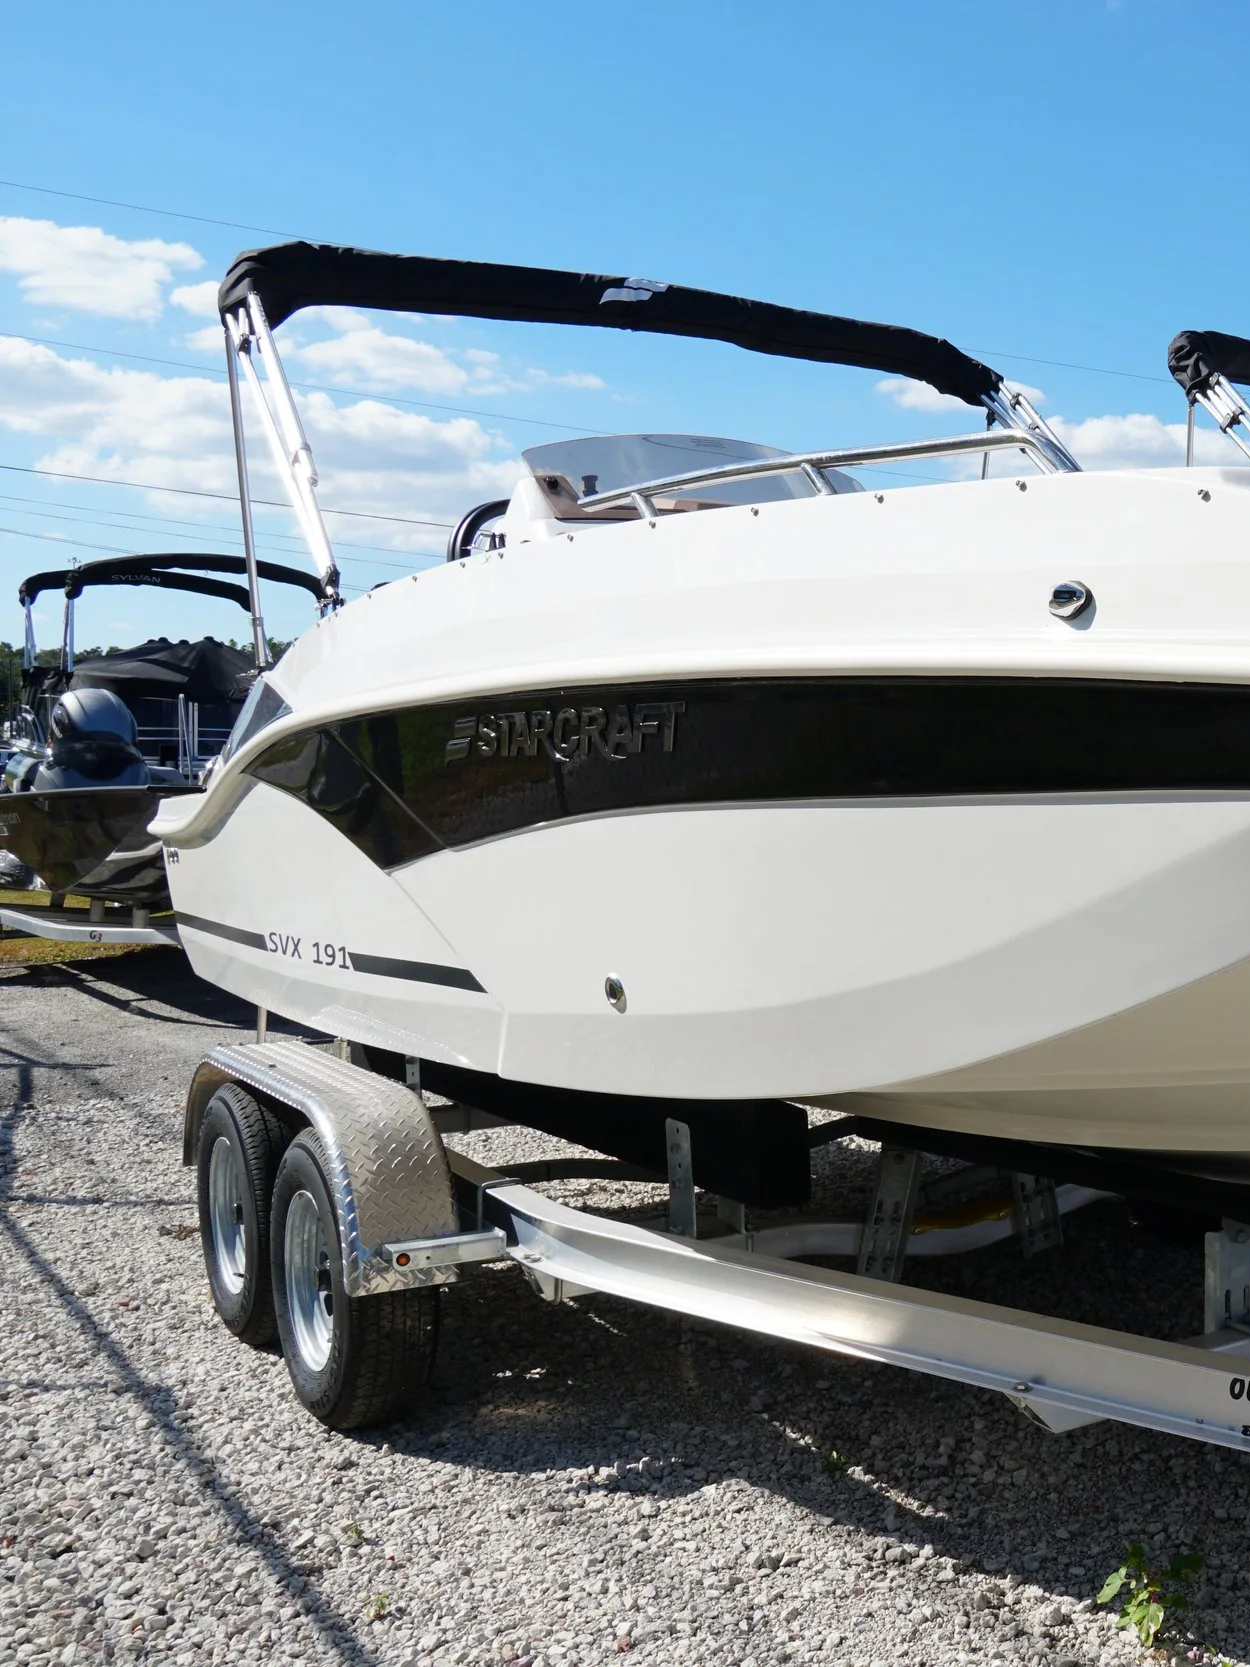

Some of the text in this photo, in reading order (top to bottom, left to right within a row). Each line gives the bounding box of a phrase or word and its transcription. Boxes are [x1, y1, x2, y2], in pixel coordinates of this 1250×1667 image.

[111, 574, 161, 583] SYLVAN
[477, 701, 686, 762] STARCRAFT
[268, 932, 350, 970] SVX 191
